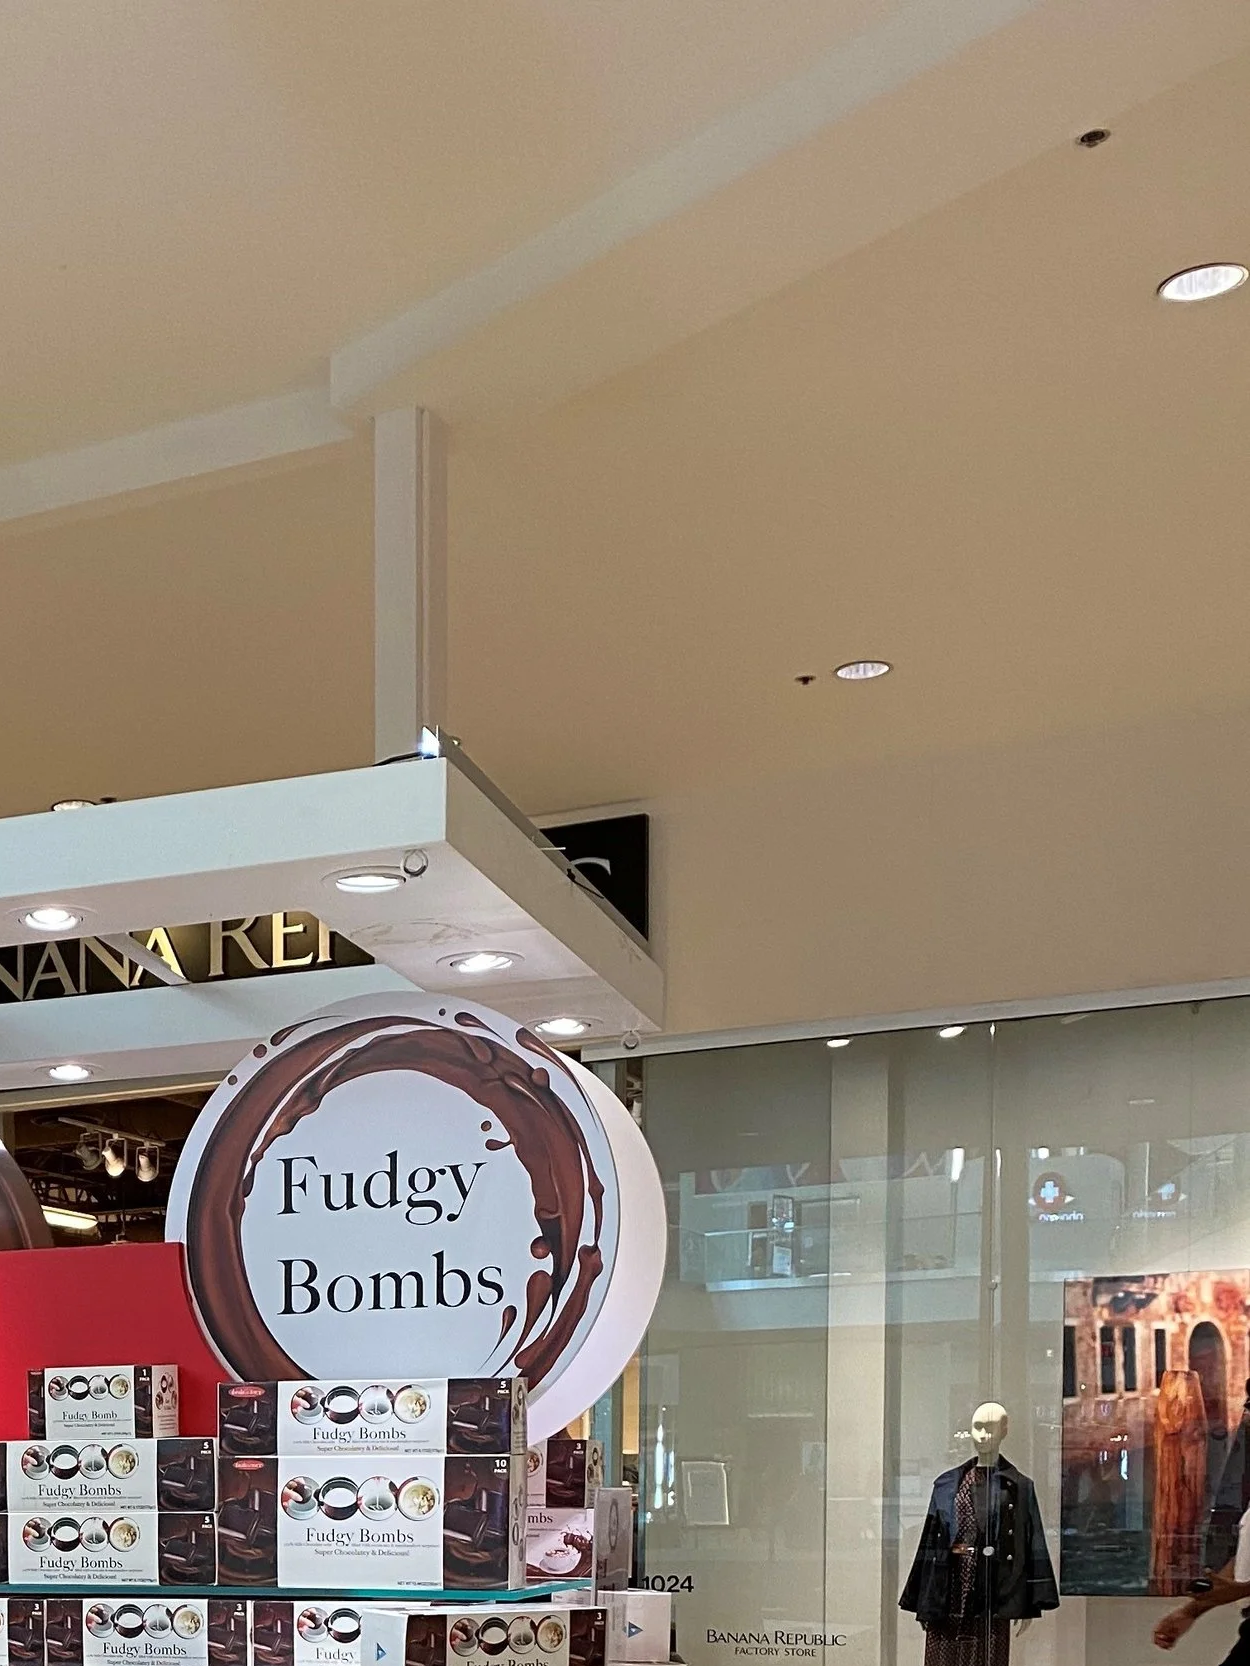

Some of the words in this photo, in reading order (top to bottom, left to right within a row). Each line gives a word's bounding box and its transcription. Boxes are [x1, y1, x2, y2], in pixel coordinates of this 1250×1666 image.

[276, 1150, 488, 1225] Fudgy
[277, 1250, 505, 1315] Bombs
[500, 1381, 507, 1389] 5
[62, 1411, 88, 1421] Fudgy
[91, 1411, 117, 1419] Bomb
[312, 1427, 354, 1443] Fudgy
[359, 1426, 406, 1440] Bombs
[494, 1460, 507, 1468] 10
[38, 1484, 76, 1499] Fudgy
[79, 1484, 122, 1496] Bombs
[527, 1512, 553, 1524] mbs
[306, 1528, 354, 1546] Fudgy
[360, 1528, 414, 1544] Bombs
[39, 1557, 78, 1571] Fudgy
[81, 1556, 123, 1568] Bombs
[642, 1575, 694, 1593] 1024
[34, 1603, 39, 1611] 3
[236, 1604, 242, 1612] 3
[597, 1612, 602, 1620] 3
[706, 1629, 770, 1644] BANANA
[774, 1630, 847, 1646] REPUBLIC
[102, 1642, 140, 1658] Fudgy
[144, 1643, 187, 1656] Bombs
[734, 1647, 780, 1656] FACTORY
[784, 1648, 817, 1657] STORE
